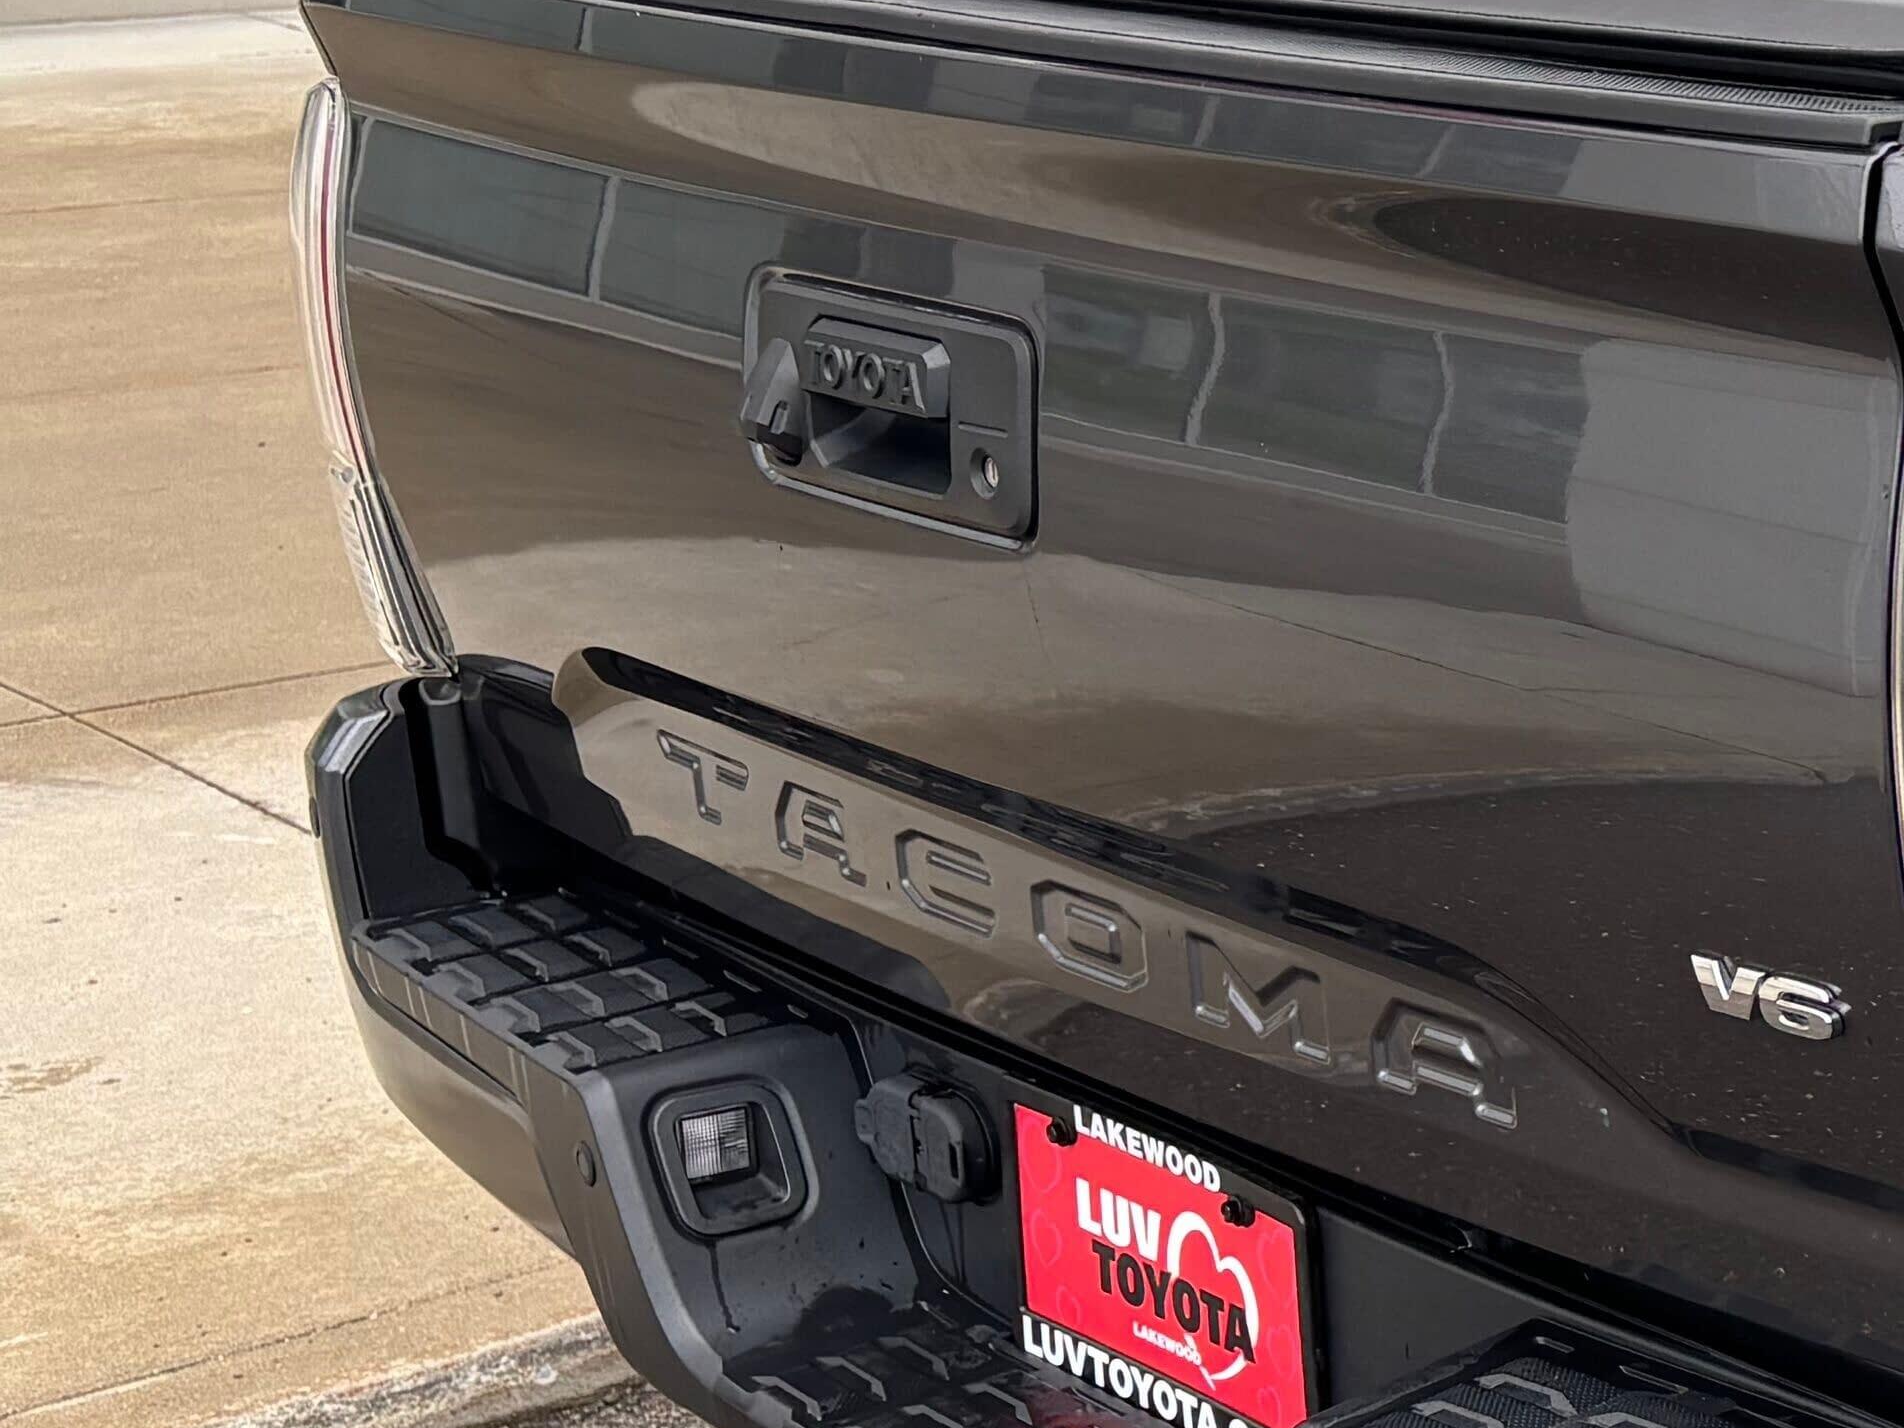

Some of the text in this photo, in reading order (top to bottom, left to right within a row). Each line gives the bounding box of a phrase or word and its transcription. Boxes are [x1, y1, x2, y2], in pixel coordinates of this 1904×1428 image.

[803, 339, 926, 414] TOYOTA
[655, 727, 1519, 1130] TACOMA
[1690, 949, 1852, 1041] V6
[1073, 1103, 1222, 1193] LAKEWOOD
[1075, 1177, 1162, 1261] LUV
[1091, 1239, 1257, 1363] TOYOTA
[1132, 1321, 1203, 1367] LAKEWOOD
